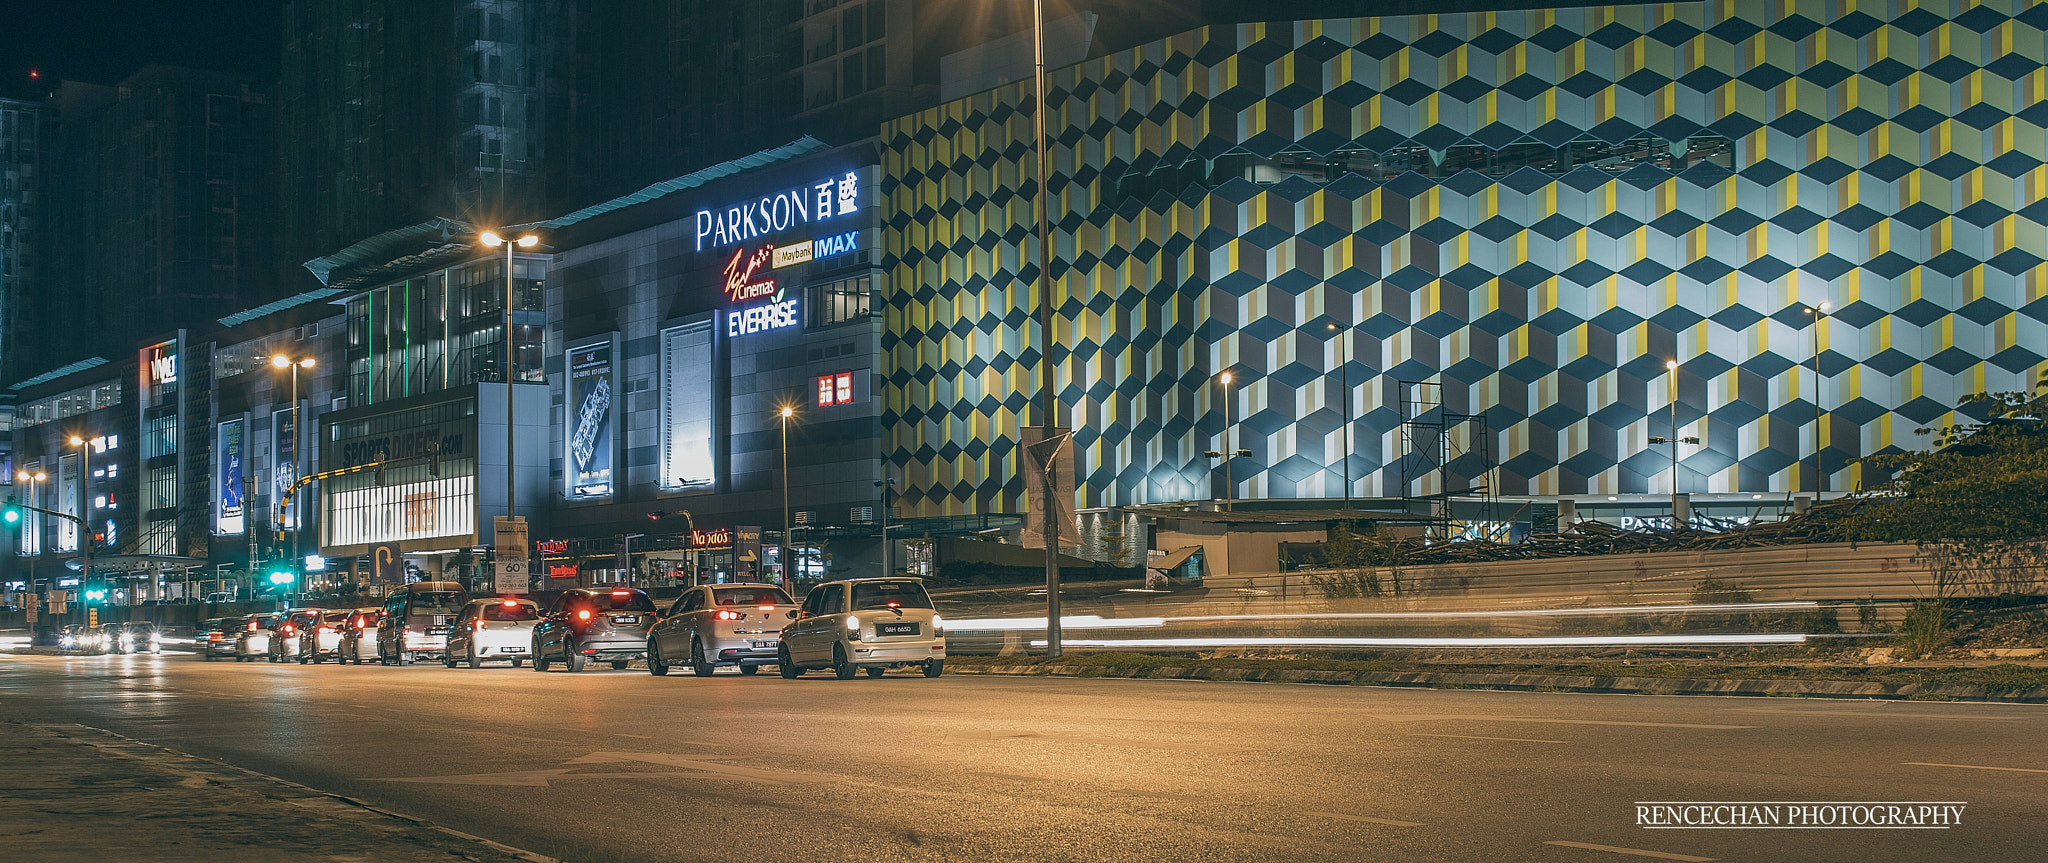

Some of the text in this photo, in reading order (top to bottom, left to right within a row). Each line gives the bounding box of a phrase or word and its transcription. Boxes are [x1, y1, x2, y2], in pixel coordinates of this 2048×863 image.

[815, 171, 858, 221] 百盛
[696, 187, 808, 253] PARKSON
[781, 245, 812, 263] Maybank
[814, 232, 858, 259] IMAX
[738, 280, 774, 300] Cinemas
[728, 299, 798, 338] EVERRISE
[1620, 517, 1720, 531] PARKON
[505, 563, 527, 573] 60%
